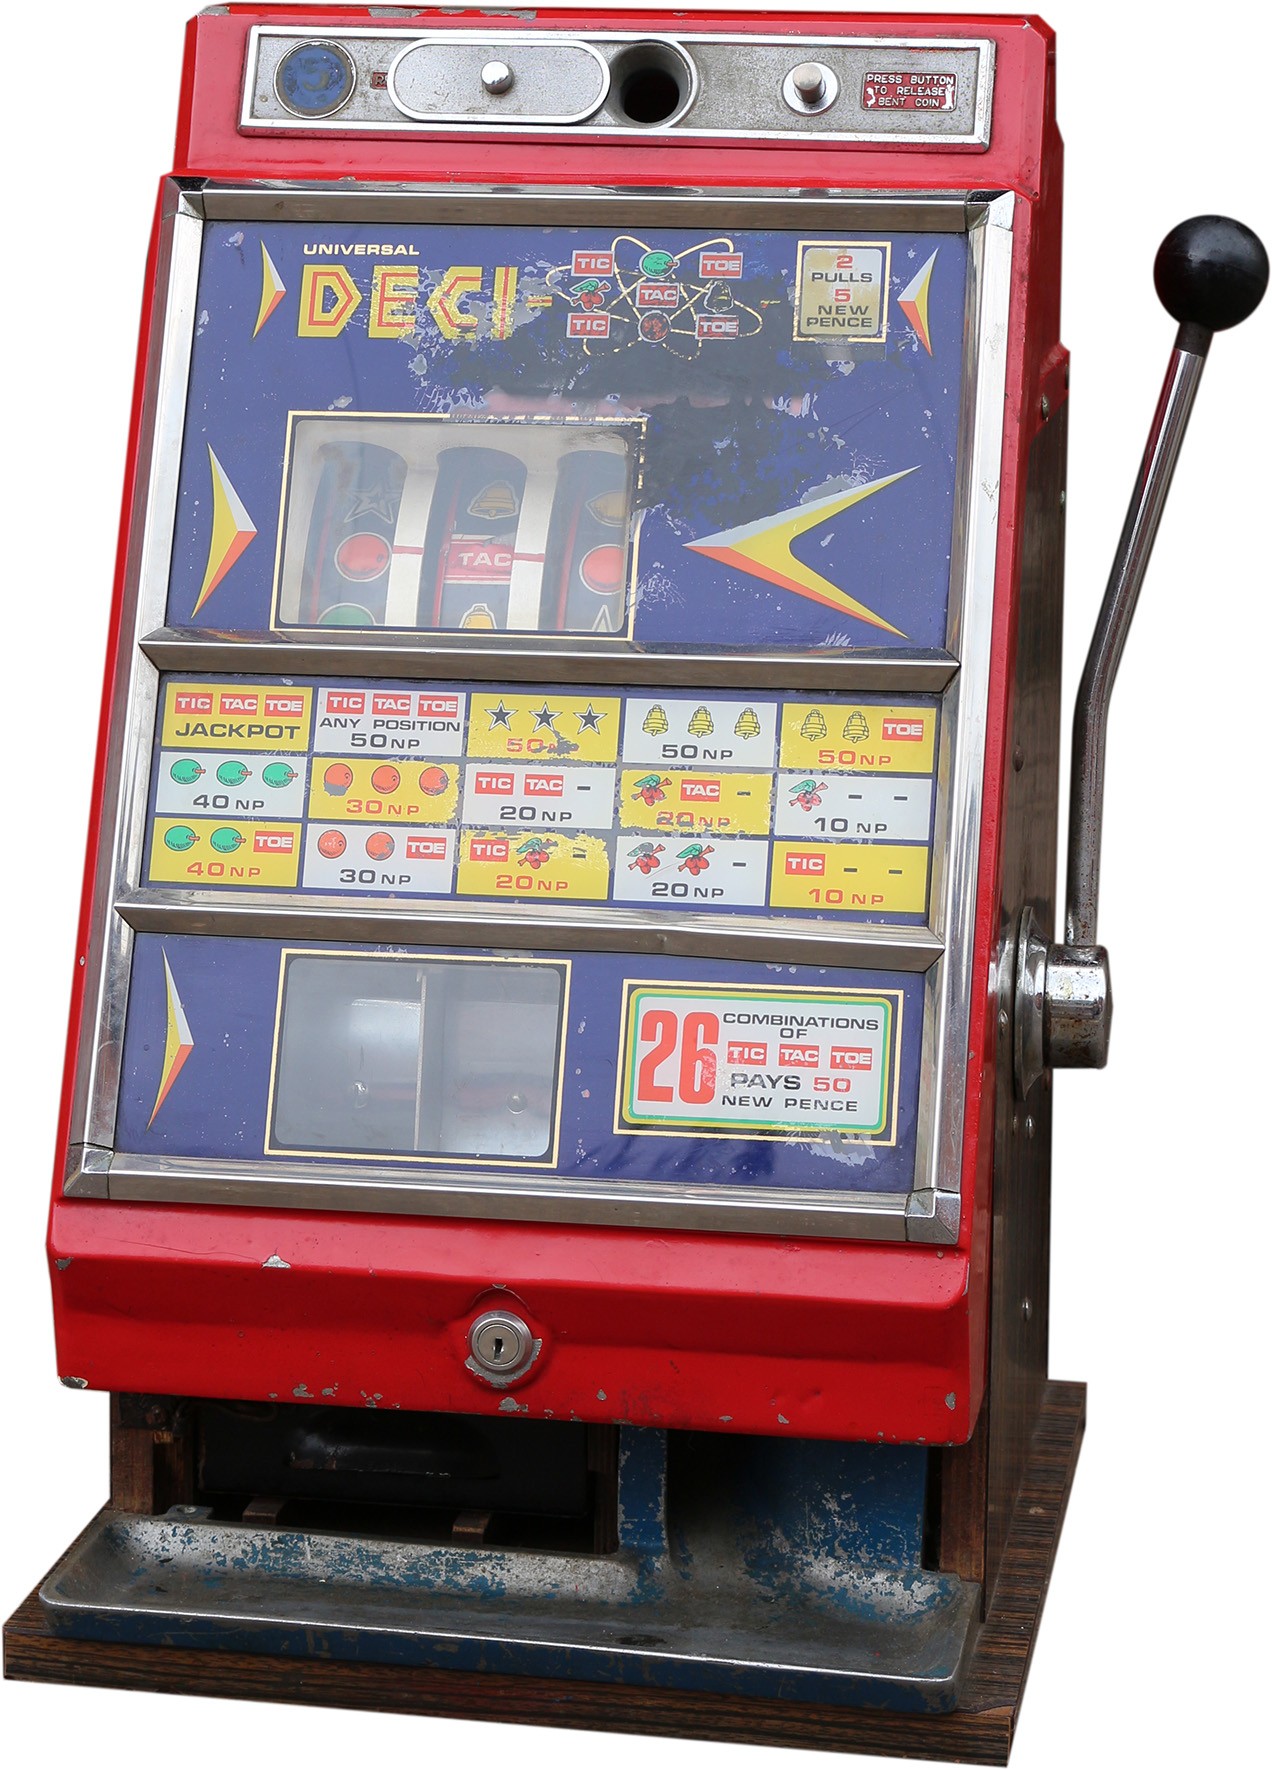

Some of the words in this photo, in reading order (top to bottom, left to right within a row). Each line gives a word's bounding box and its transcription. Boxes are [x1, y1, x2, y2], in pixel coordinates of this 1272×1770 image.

[866, 73, 903, 84] PRESS
[910, 74, 954, 86] BUTTON
[874, 85, 888, 94] TO
[896, 86, 946, 96] RELEASE
[877, 96, 906, 107] BENT
[915, 97, 940, 107] COIN
[303, 243, 420, 256] UNIVERSAL
[577, 257, 610, 270] TIC
[702, 259, 741, 272] TOE
[836, 254, 853, 269] 2
[811, 272, 873, 283] PULLS
[640, 288, 680, 301] TAC
[834, 288, 851, 303] 5
[817, 305, 870, 315] NEW
[572, 319, 607, 331] TIC
[699, 320, 739, 333] TOE
[806, 316, 873, 328] PENCE
[457, 551, 512, 568] TAC
[177, 696, 212, 710] TIC
[221, 697, 258, 711] TAC
[265, 699, 304, 713] TOE
[329, 696, 364, 709] TIC
[373, 698, 410, 711] TAC
[419, 699, 459, 713] TOE
[174, 722, 301, 740] JACKPOT
[319, 717, 362, 729] ANY
[372, 719, 461, 732] POSITION
[883, 721, 924, 736] TOE
[350, 732, 387, 749] 50
[390, 737, 421, 750] NP
[661, 743, 698, 760] 50
[702, 748, 734, 761] NP
[477, 776, 512, 790] TIC
[525, 778, 563, 792] TAC
[681, 782, 720, 797] TAC
[192, 794, 230, 810] 40
[235, 799, 265, 811] NP
[345, 798, 383, 815] 30
[387, 803, 420, 816] NP
[499, 805, 537, 821] 20
[541, 810, 573, 822] NP
[813, 816, 849, 833] 10
[856, 822, 888, 834] NP
[255, 834, 294, 849] TOE
[406, 840, 446, 854] TOE
[472, 843, 507, 856] TIC
[186, 860, 225, 877] 40
[230, 866, 261, 878] NP
[787, 856, 824, 871] TIC
[338, 868, 376, 885] 30
[380, 873, 412, 886] NP
[495, 874, 534, 890] 20
[537, 879, 569, 892] NP
[651, 881, 689, 898] 20
[693, 886, 725, 899] NP
[808, 887, 844, 905] 10
[850, 893, 885, 905] NP
[722, 1012, 880, 1031] COMBINATIONS
[779, 1027, 809, 1040] OF
[637, 1009, 720, 1105] 26
[727, 1045, 766, 1061] TIC
[779, 1047, 819, 1063] TAC
[831, 1050, 873, 1065] TOE
[729, 1072, 802, 1091] PAYS
[812, 1076, 852, 1093] 50
[721, 1094, 773, 1109] NEW
[784, 1098, 859, 1113] PENCE
